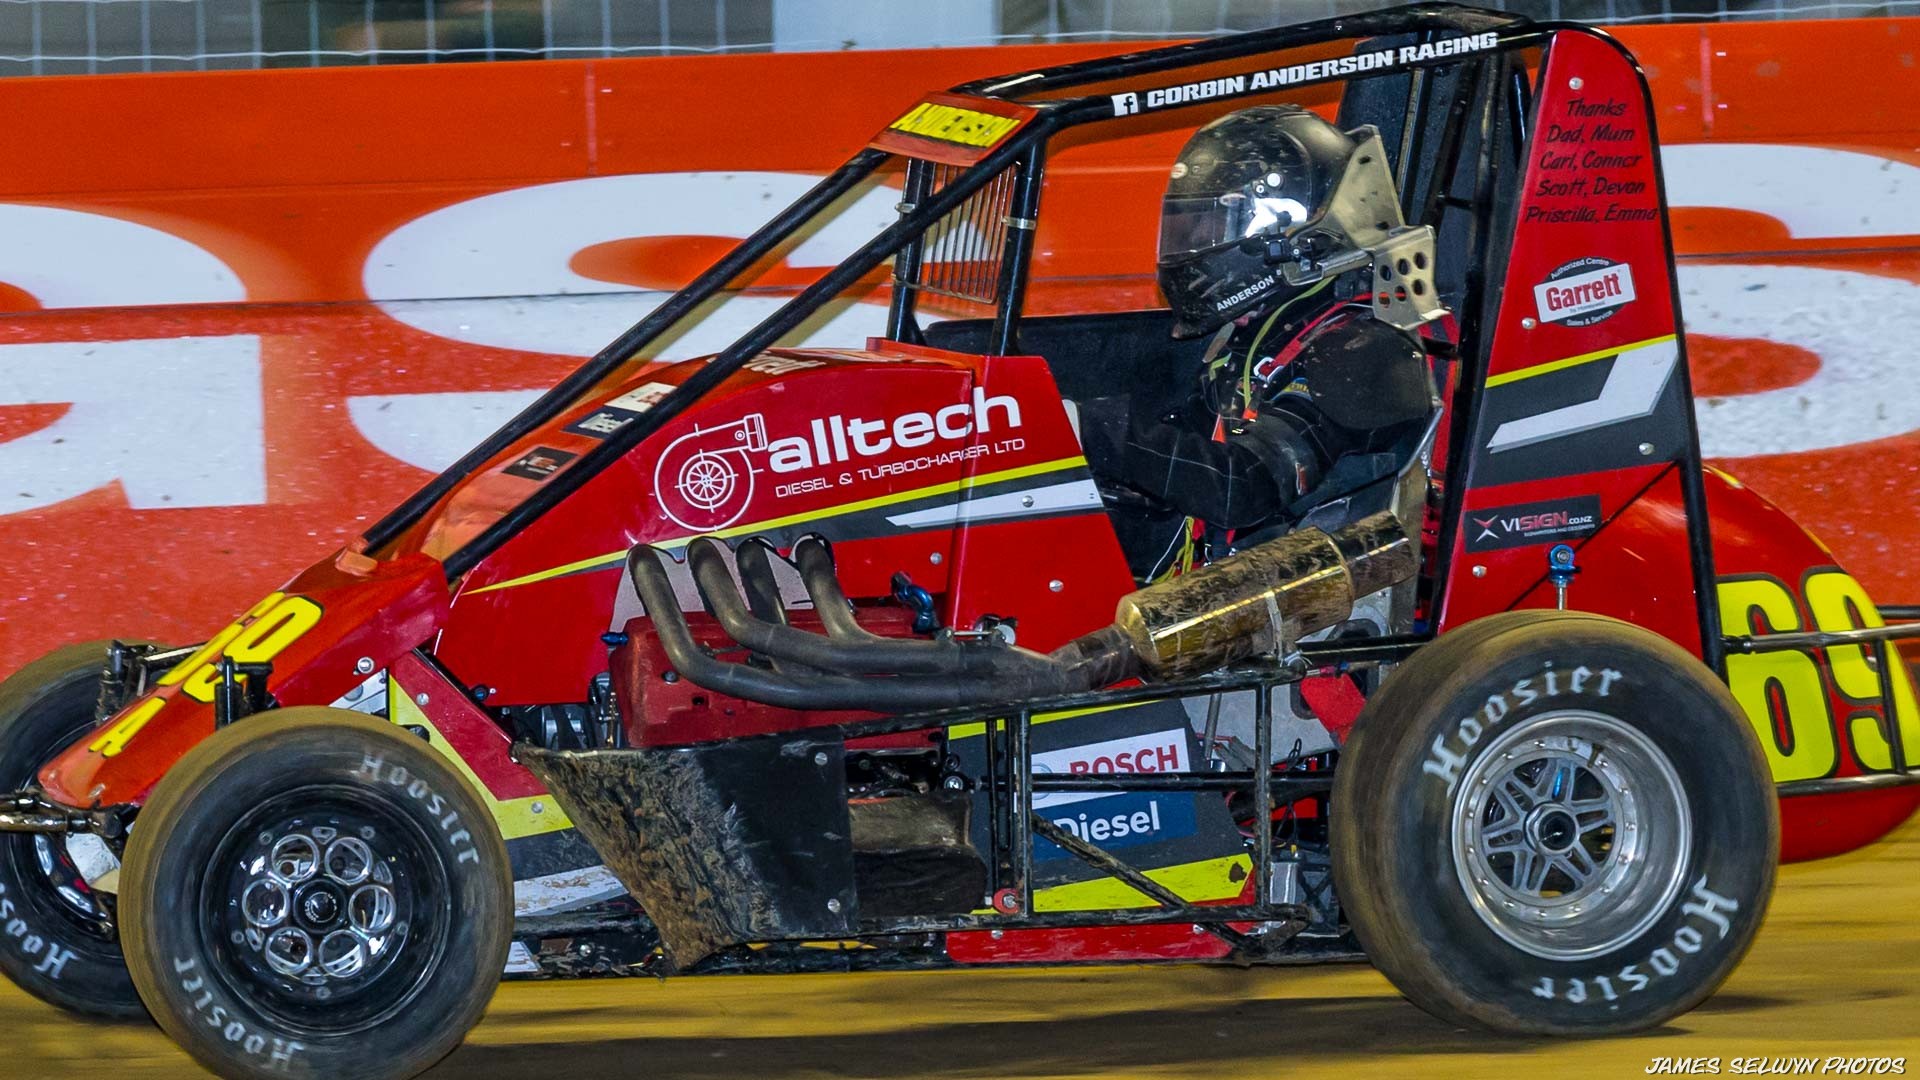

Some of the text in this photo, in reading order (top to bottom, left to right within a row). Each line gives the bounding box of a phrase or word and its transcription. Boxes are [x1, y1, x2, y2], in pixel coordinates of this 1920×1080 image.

[1147, 75, 1245, 108] CORBIN
[1250, 50, 1395, 90] ANDERSON
[1399, 31, 1499, 64] RACING
[1567, 98, 1626, 117] Thanks
[1547, 124, 1635, 143] Dad, Mum
[1539, 150, 1577, 171] Carl,
[1536, 179, 1588, 198] Scott,
[1525, 203, 1659, 224] Priscilla, Emma
[1216, 275, 1275, 311] ANDERSON
[1546, 273, 1622, 311] Garrett
[766, 386, 1022, 473] alltech
[775, 438, 1025, 498] DIESEL & TURBOCHARGER LTD
[1714, 566, 1920, 784] 69
[1422, 660, 1623, 800] Hoosier
[1069, 744, 1180, 774] BOSCH
[1053, 800, 1161, 842] Diesel
[1530, 873, 1739, 1011] Hoosier
